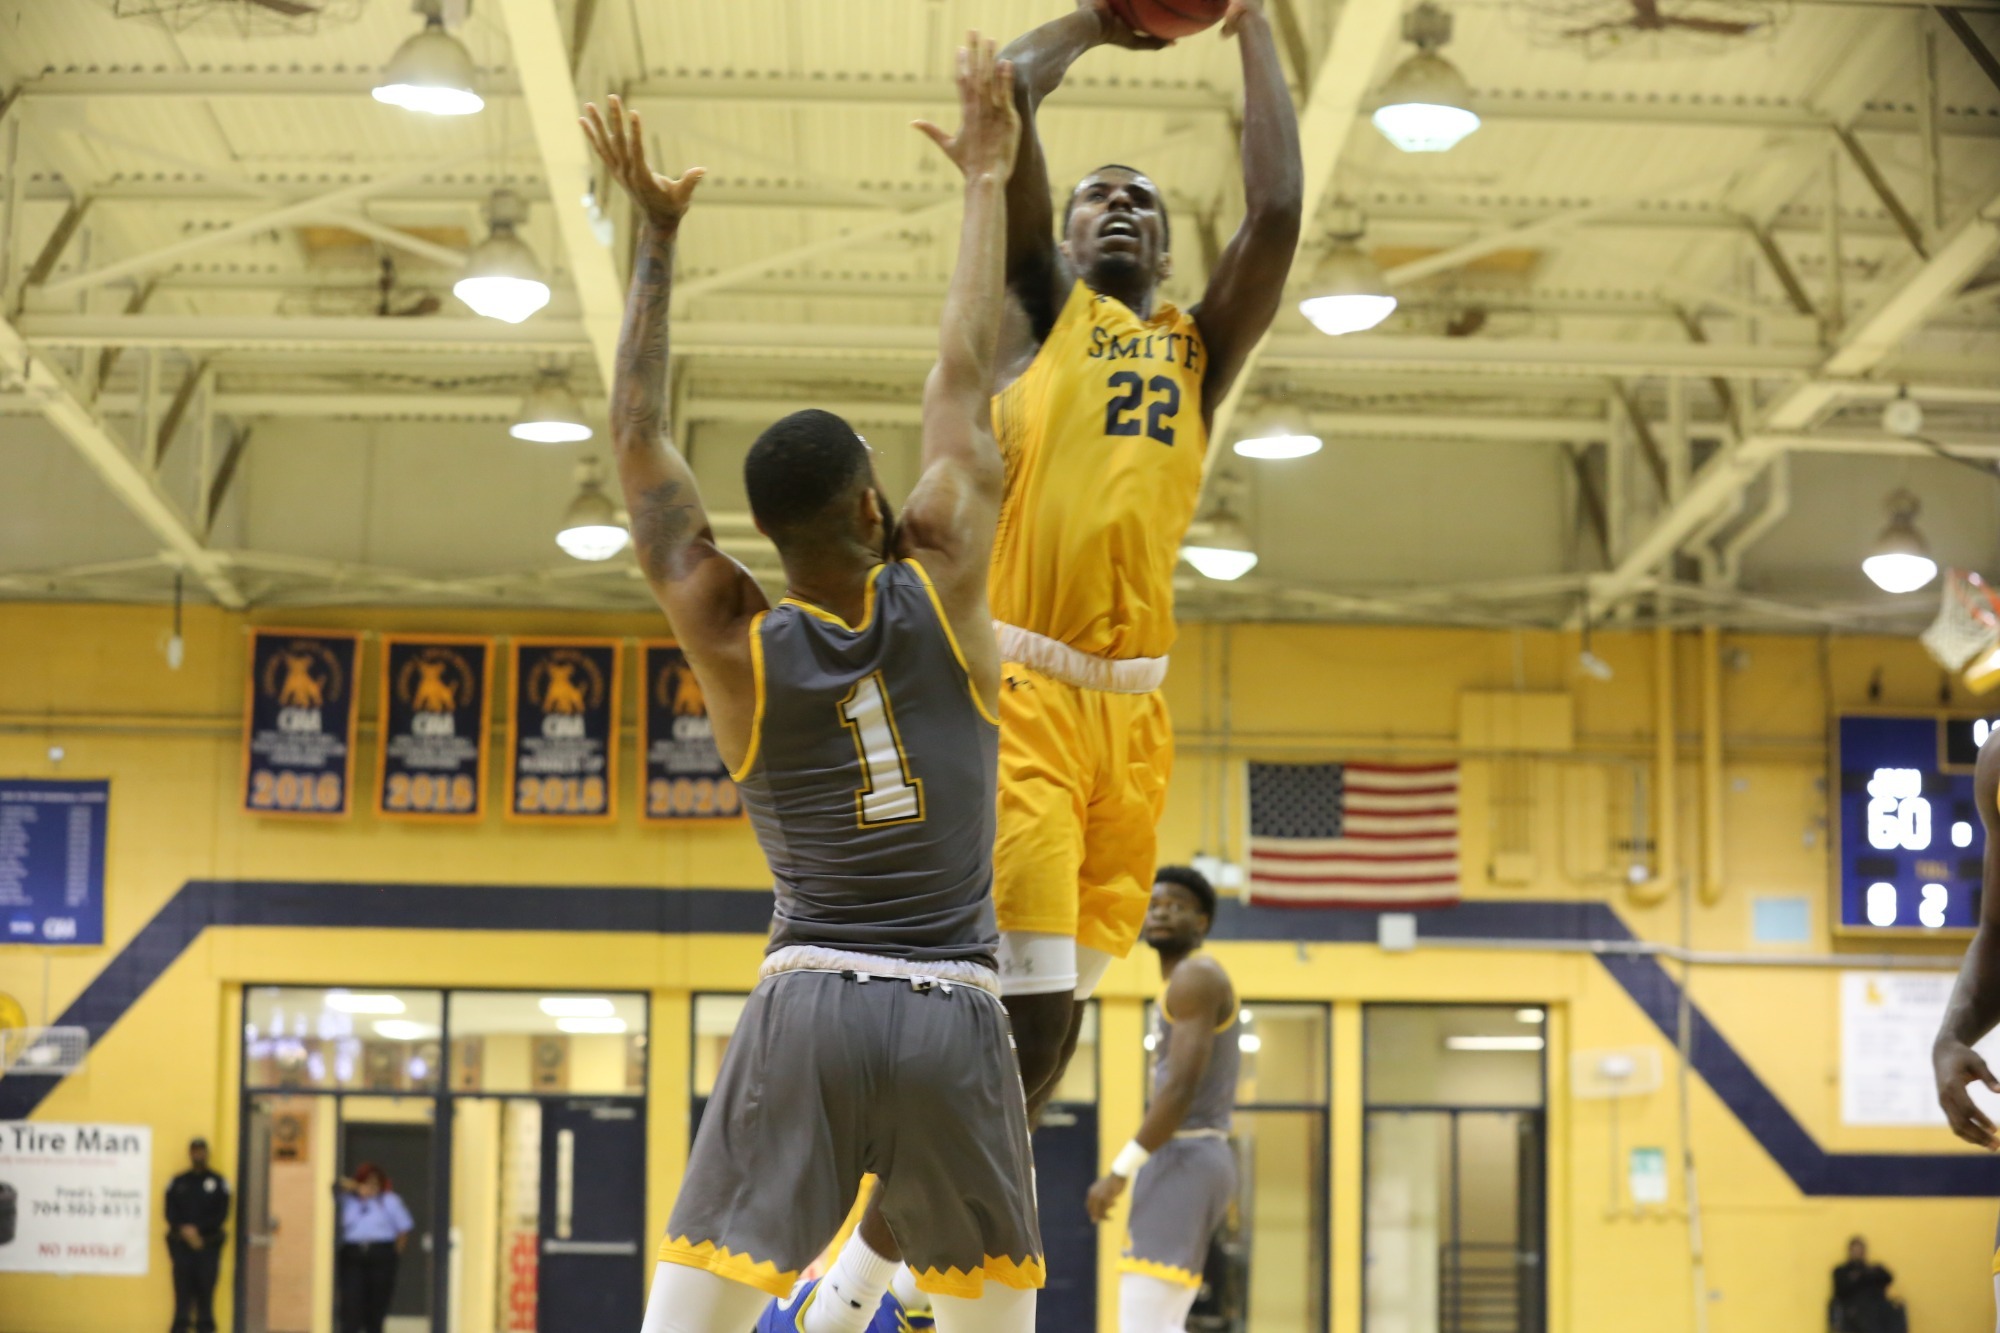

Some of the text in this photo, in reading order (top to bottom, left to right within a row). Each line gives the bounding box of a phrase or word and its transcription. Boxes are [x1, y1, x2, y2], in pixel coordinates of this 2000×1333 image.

[1104, 371, 1180, 447] 22
[836, 669, 926, 829] 1
[1868, 797, 1931, 850] 60
[1919, 883, 1948, 928] 2
[11, 1126, 66, 1151] Tire
[76, 1127, 141, 1153] Man
